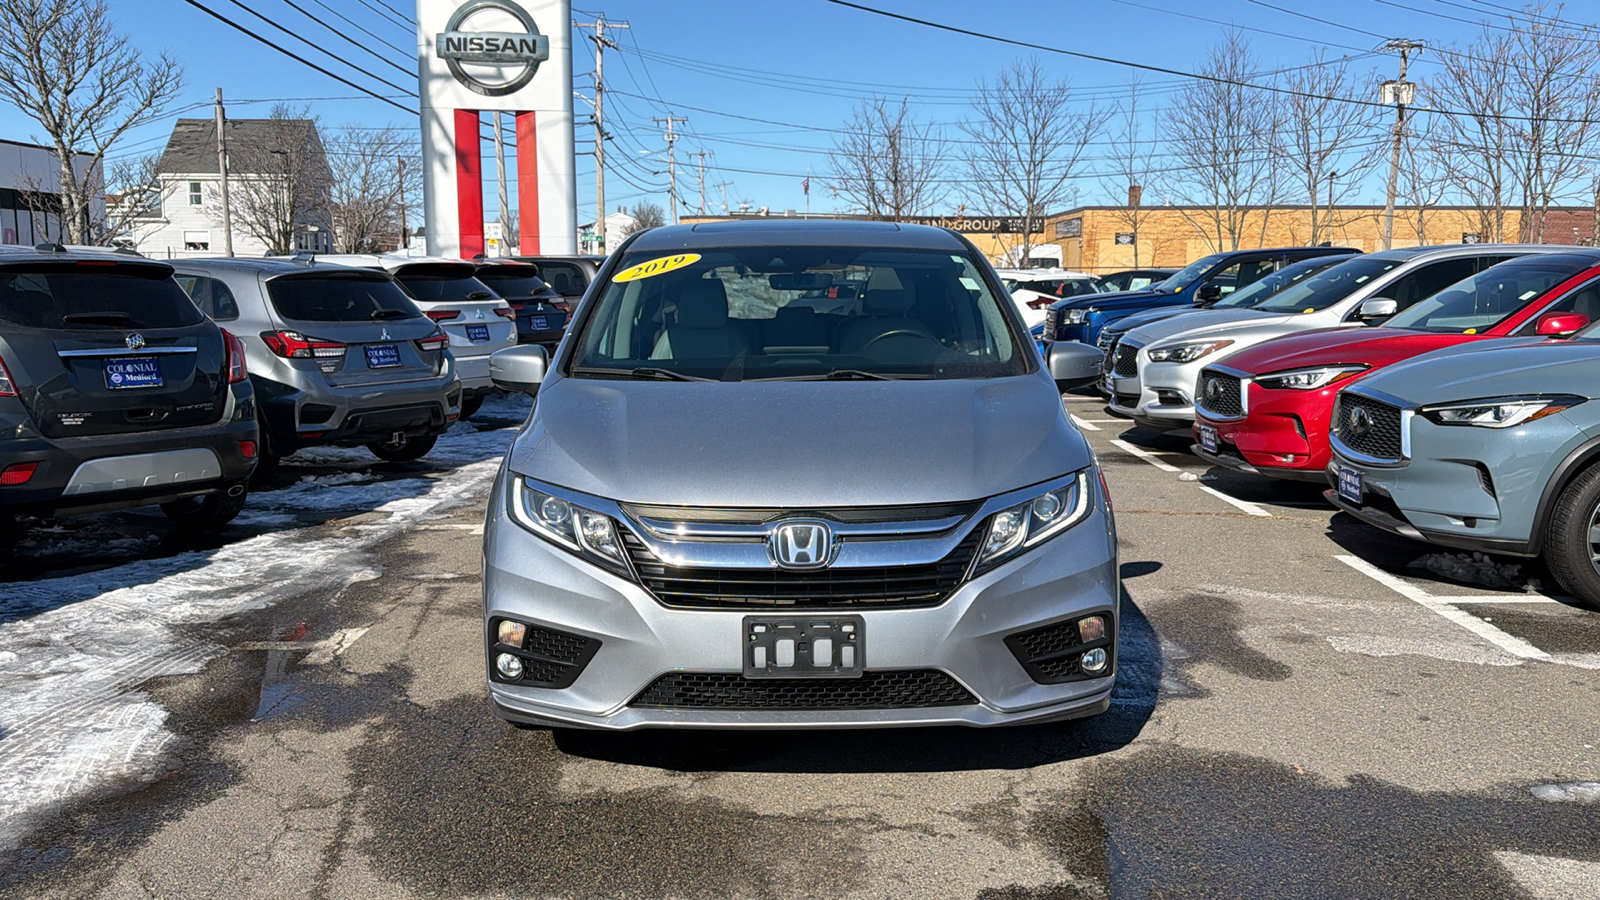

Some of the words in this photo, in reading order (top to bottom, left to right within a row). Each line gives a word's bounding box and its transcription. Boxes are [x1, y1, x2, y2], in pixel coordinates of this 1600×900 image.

[445, 37, 537, 54] NISSAN
[955, 219, 1001, 231] GROUP
[629, 255, 686, 278] 2019
[367, 349, 398, 357] COLONIAL
[106, 363, 157, 374] COLONIAL
[125, 373, 157, 381] Medford
